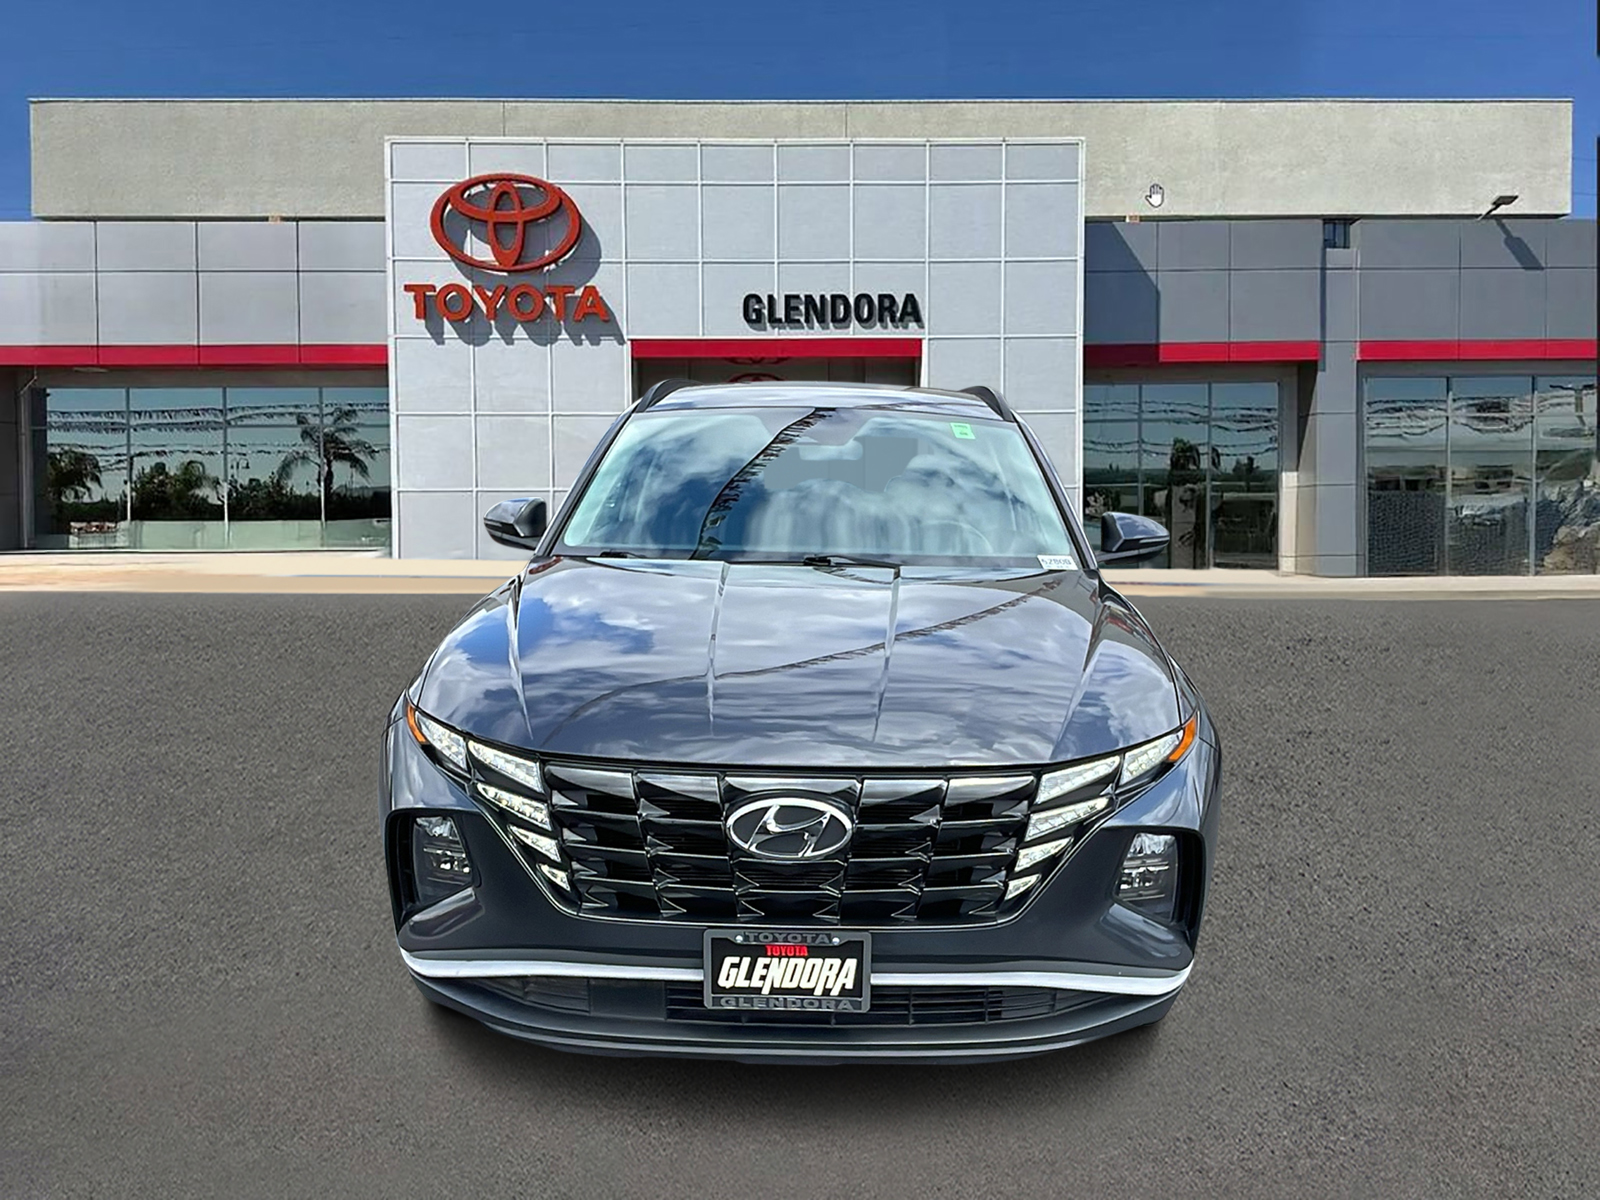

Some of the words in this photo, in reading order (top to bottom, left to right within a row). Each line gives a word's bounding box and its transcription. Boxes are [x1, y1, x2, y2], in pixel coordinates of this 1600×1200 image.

[404, 283, 610, 323] TOYOTA
[743, 293, 922, 324] GLENDORA
[745, 932, 830, 944] TOYOTA
[765, 944, 808, 957] TOYOTA
[717, 956, 858, 996] GLENDORA
[720, 996, 855, 1011] GLENDORA
